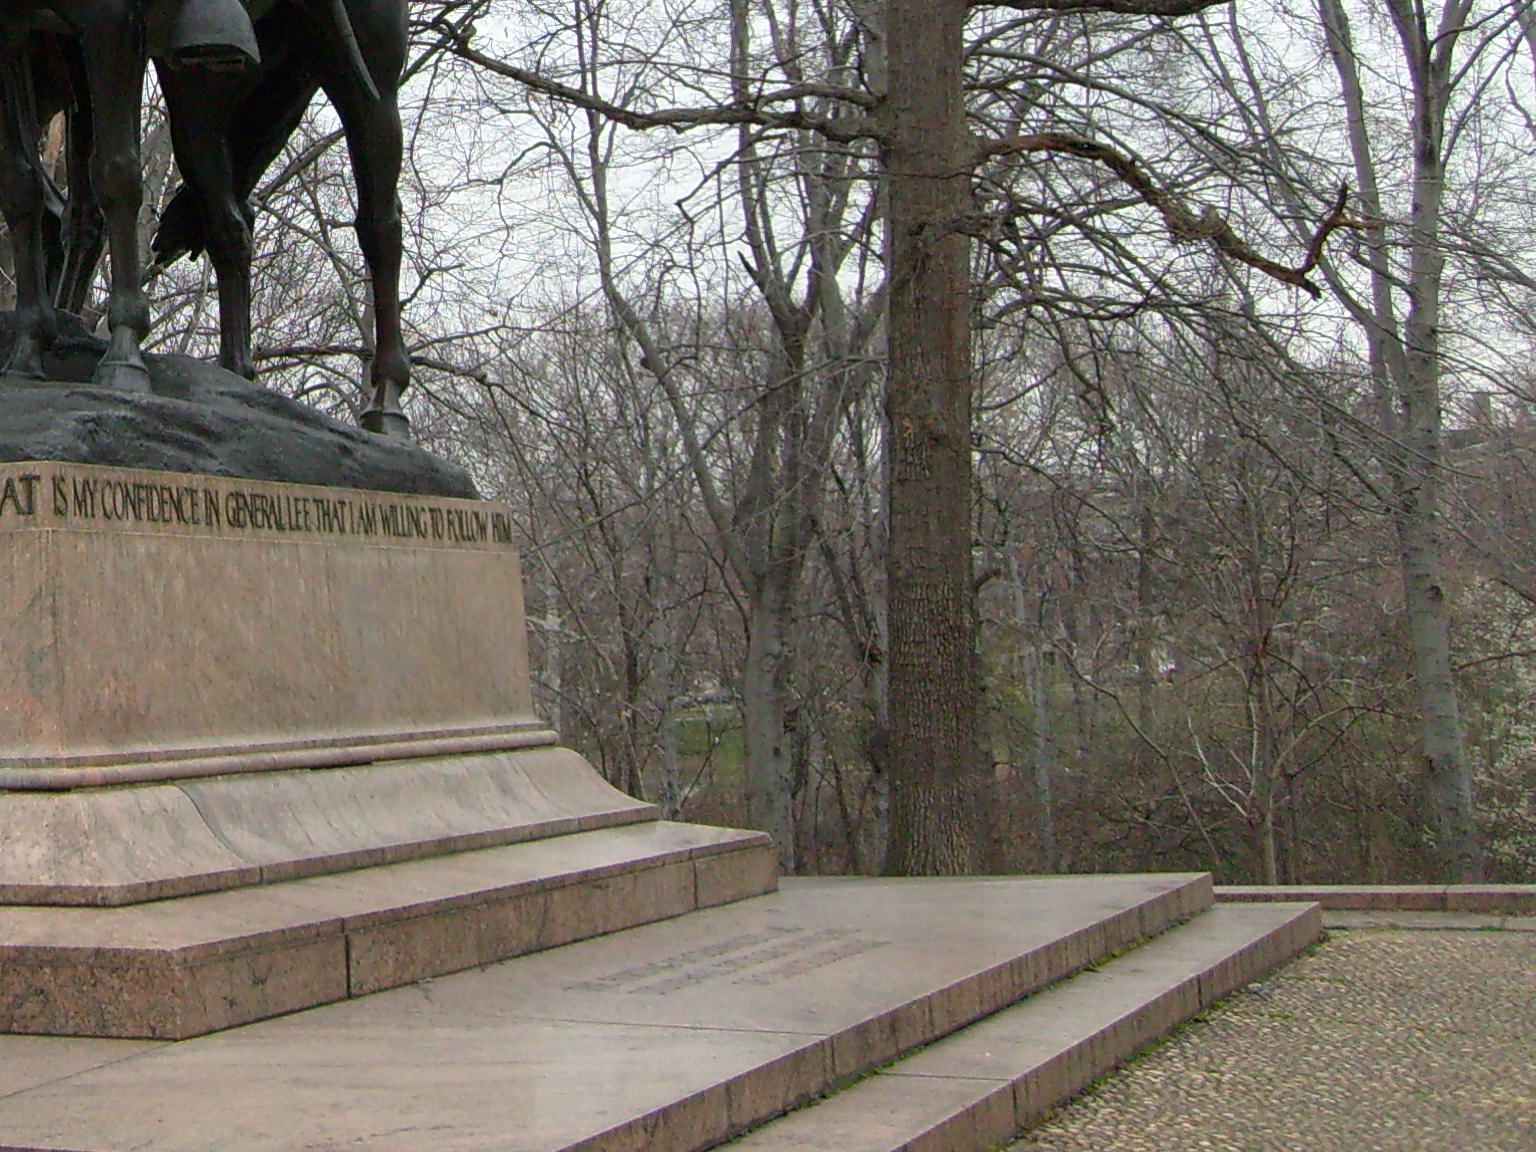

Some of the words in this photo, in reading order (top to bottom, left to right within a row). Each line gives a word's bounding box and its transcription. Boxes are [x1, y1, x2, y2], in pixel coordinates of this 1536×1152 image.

[52, 475, 68, 516] IS
[73, 477, 97, 519] MY
[101, 480, 199, 525] CONFIDENCE
[204, 488, 220, 528] IN
[226, 491, 286, 531] GENERAL
[287, 495, 311, 533] LEE
[314, 498, 346, 534] THAT
[357, 503, 378, 536] AM
[379, 504, 428, 539] WILLING
[429, 507, 445, 540] TO
[446, 508, 488, 543] FOLLOW
[491, 512, 512, 544] HIM
